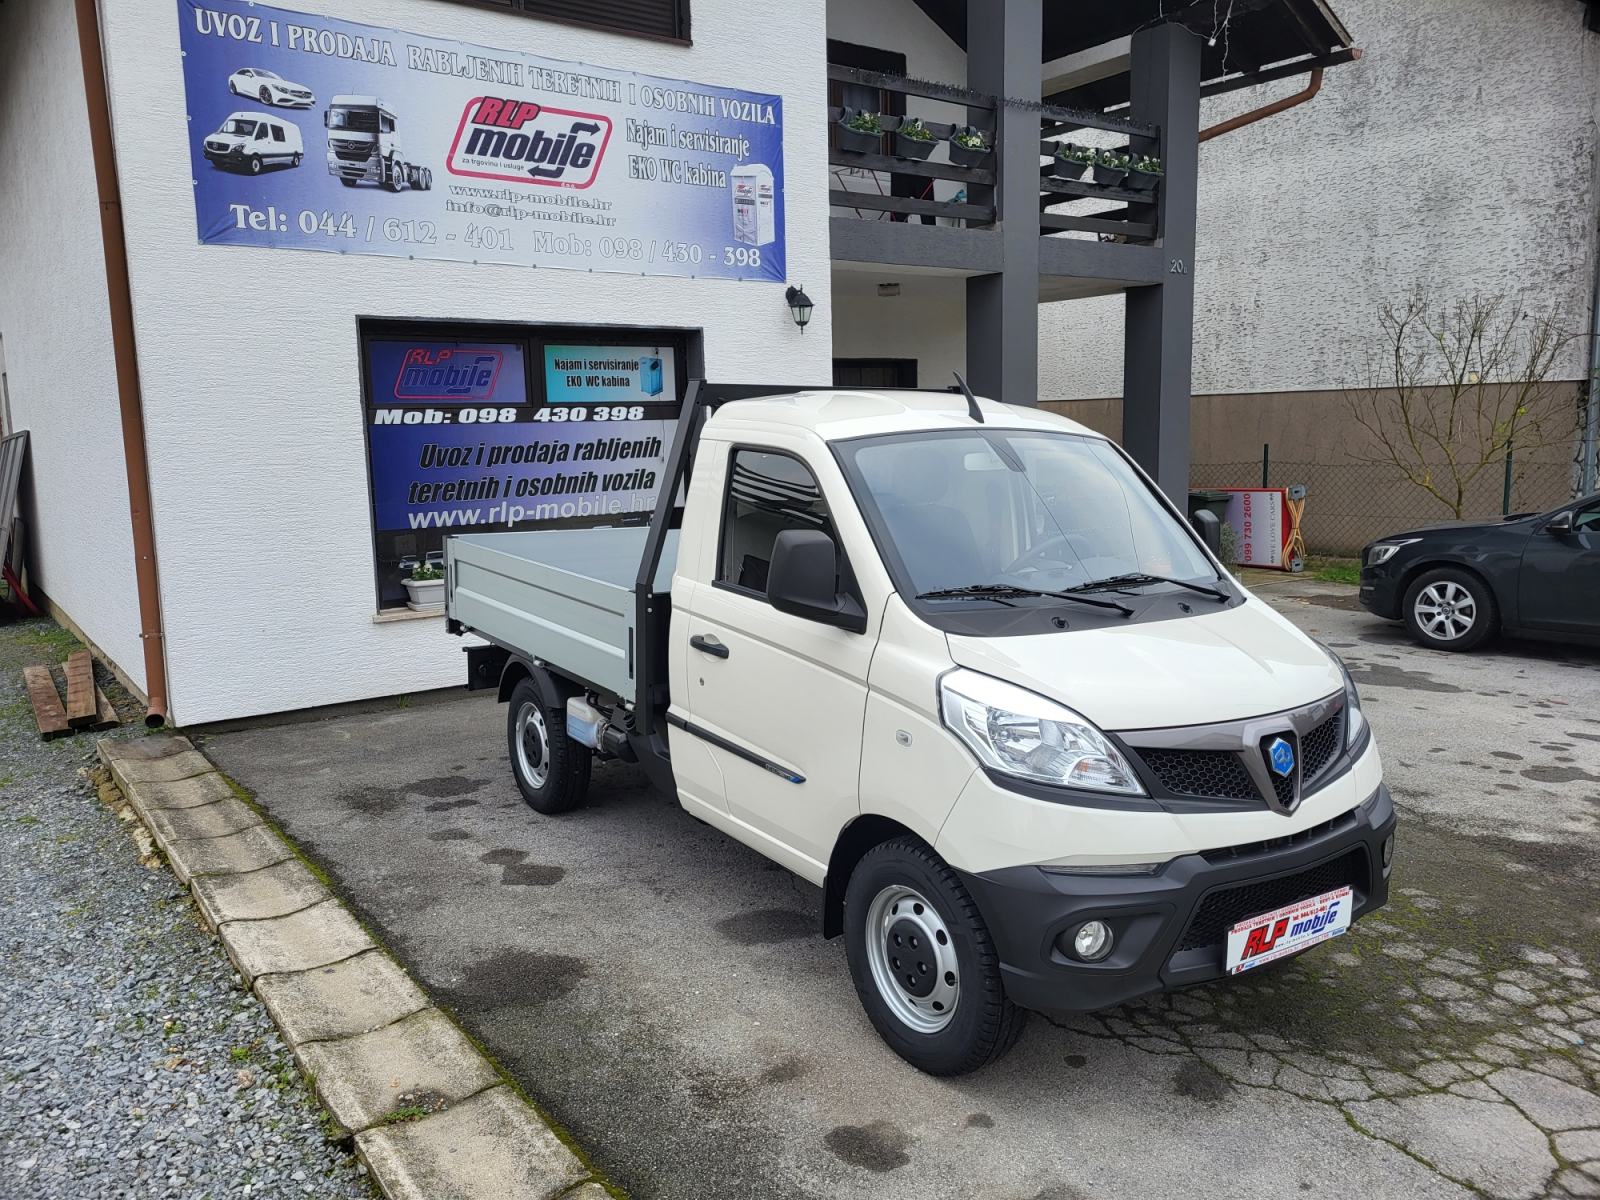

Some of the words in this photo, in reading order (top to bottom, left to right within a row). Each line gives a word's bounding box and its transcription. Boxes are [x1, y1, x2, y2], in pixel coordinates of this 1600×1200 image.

[193, 7, 264, 43] UVOZ
[270, 22, 281, 47] I
[287, 24, 398, 67] PRODAJA
[406, 44, 525, 87] RABLJENIH
[528, 65, 622, 102] TERETNIH
[628, 83, 636, 105] I
[641, 86, 716, 117] OSOBNIH
[720, 97, 776, 125] VOZILA
[471, 96, 541, 130] RLP
[464, 126, 597, 170] mobile
[625, 118, 669, 148] Najam
[671, 125, 677, 147] i
[679, 128, 751, 161] servisiranje
[471, 158, 499, 168] trgovinu
[503, 163, 525, 171] usluge
[628, 154, 657, 181] EKO
[660, 160, 682, 184] WC
[683, 160, 727, 189] kabina
[446, 200, 617, 227] info@rlp-mobile.hr
[449, 185, 612, 211] www.rlp-mobile.hr
[229, 203, 289, 233] Tel:
[297, 208, 358, 239] 044
[366, 216, 375, 243] /
[382, 217, 438, 246] 612
[446, 233, 456, 241] -
[463, 222, 514, 251] 401
[533, 230, 592, 257] Mob:
[599, 235, 644, 264] 098
[648, 240, 657, 265] /
[661, 239, 703, 265] 430
[722, 246, 761, 268] 398
[408, 349, 454, 366] RLP
[553, 357, 582, 372] Najam
[589, 358, 640, 374] servisiranje
[403, 361, 493, 390] mobile
[566, 375, 583, 388] EKO
[585, 375, 601, 388] WC
[601, 374, 631, 388] kabina
[374, 408, 451, 425] Mob:
[458, 407, 518, 424] 098
[533, 406, 588, 423] 430
[592, 406, 645, 422] 398
[419, 442, 474, 469] Uvoz
[475, 442, 485, 466] i
[487, 440, 572, 468] prodaja
[574, 436, 662, 463] rabljenih
[407, 475, 500, 505] teretnih
[502, 474, 513, 498] i
[514, 471, 599, 498] osobnih
[601, 468, 656, 492] vozila
[407, 492, 656, 530] www.rlp-mobile.hr
[1243, 493, 1252, 519] 2600
[1243, 521, 1252, 540] 730
[1243, 543, 1252, 562] 099
[1290, 906, 1338, 937] mobile
[1240, 917, 1290, 961] RLP
